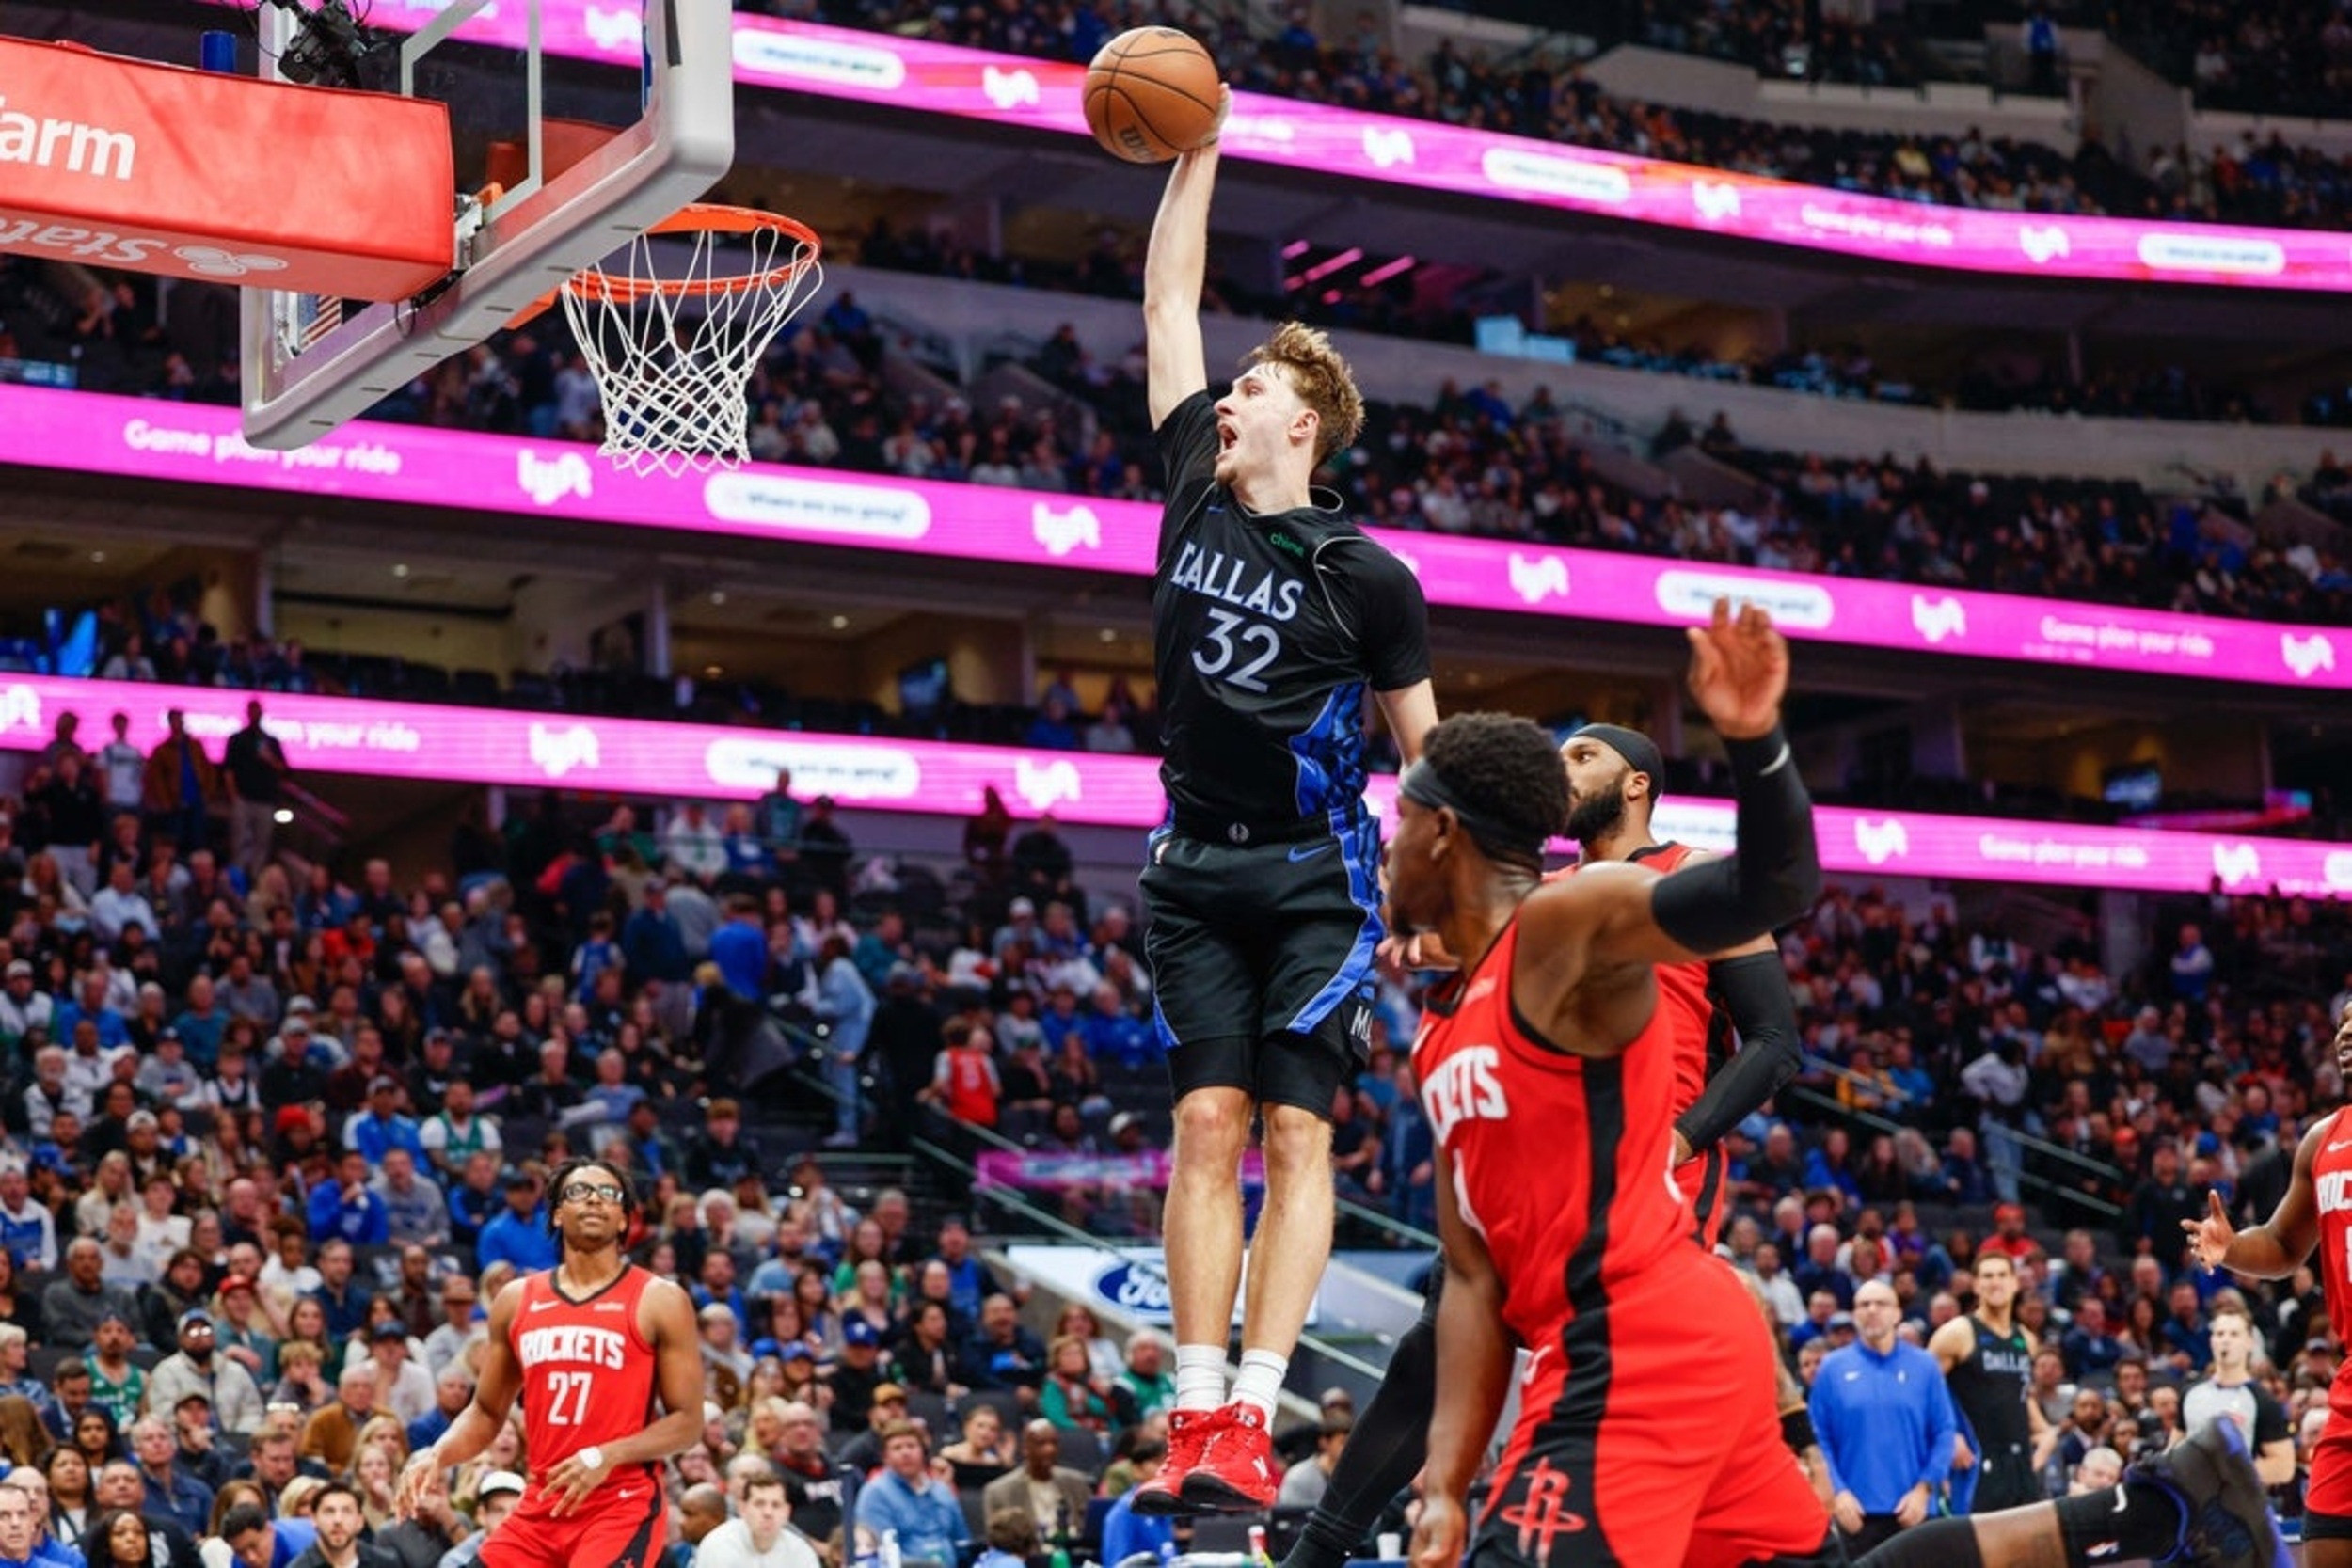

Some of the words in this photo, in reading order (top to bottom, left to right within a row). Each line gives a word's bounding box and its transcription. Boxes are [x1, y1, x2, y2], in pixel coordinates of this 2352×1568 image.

[0, 110, 135, 181] arm
[0, 218, 167, 262] Stat
[124, 419, 211, 455] Game
[345, 442, 401, 475] ride
[1191, 607, 1280, 694] 32
[519, 1324, 626, 1370] ROCKETS
[547, 1370, 593, 1426] 27
